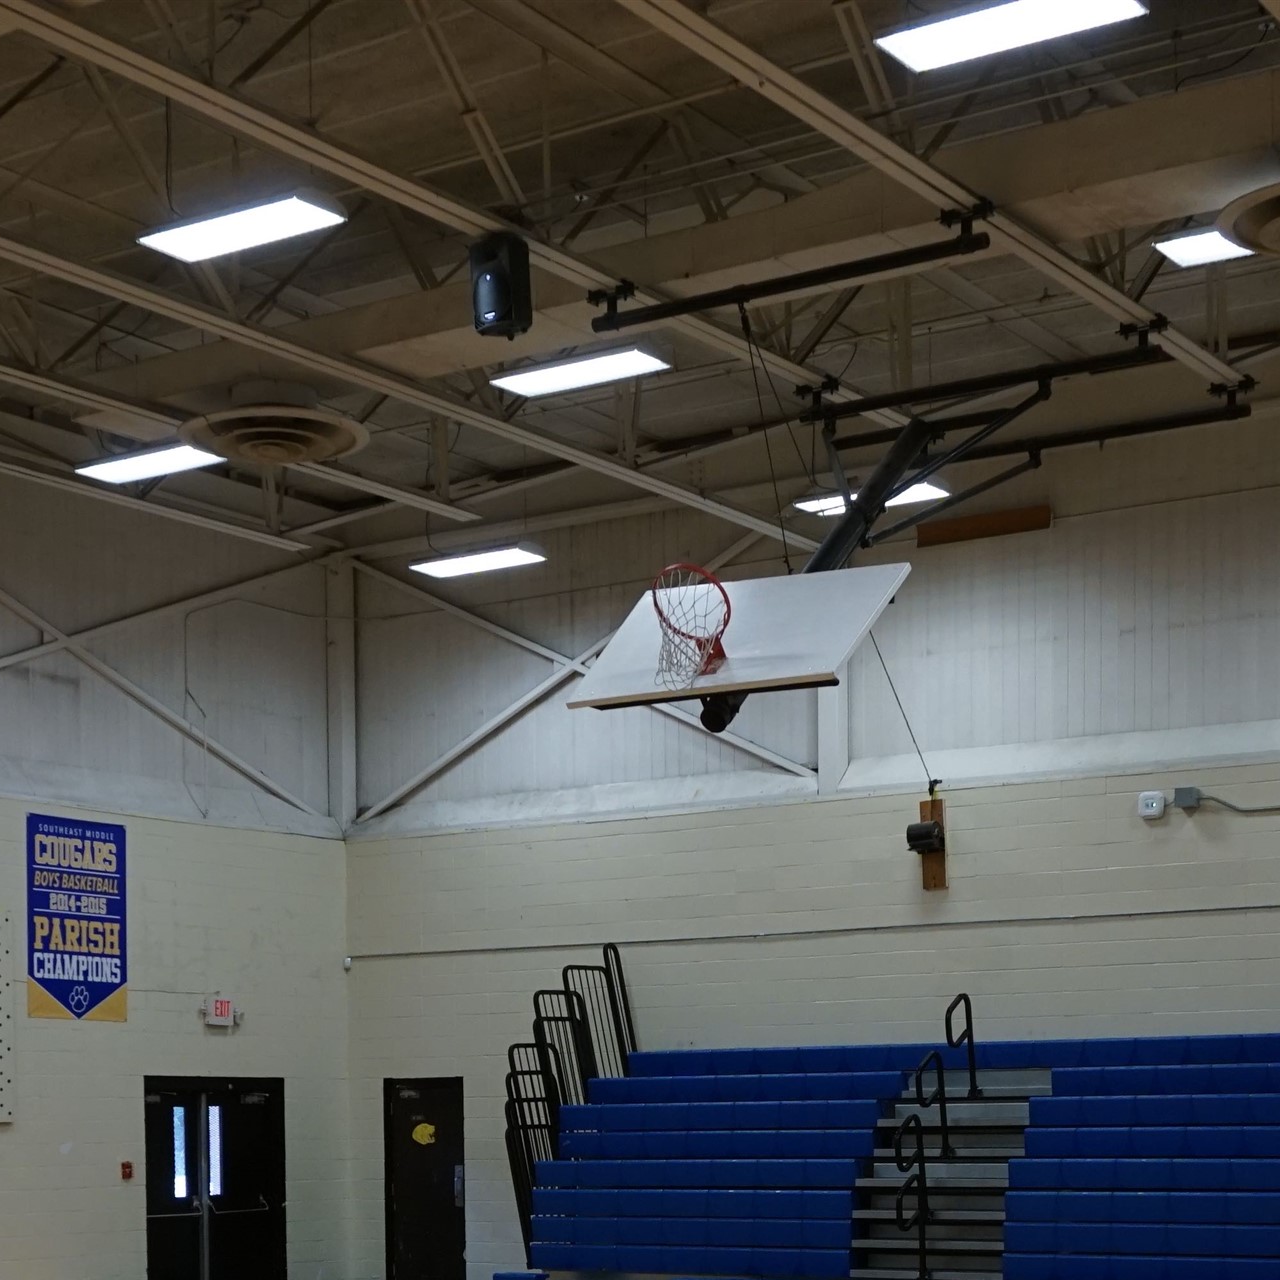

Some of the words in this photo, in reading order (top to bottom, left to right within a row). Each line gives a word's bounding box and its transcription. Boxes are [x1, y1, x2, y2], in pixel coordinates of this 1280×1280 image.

[38, 823, 82, 837] SOUTHEAST
[85, 830, 114, 841] MIDDLE
[34, 833, 117, 873] COUGARS
[34, 870, 60, 888] BOYS
[62, 873, 118, 893] BASKETBALL
[49, 892, 107, 915] 2014-2015
[33, 915, 120, 955] PARISH
[33, 951, 121, 984] CHAMPIONS
[215, 1000, 231, 1017] EXIT
